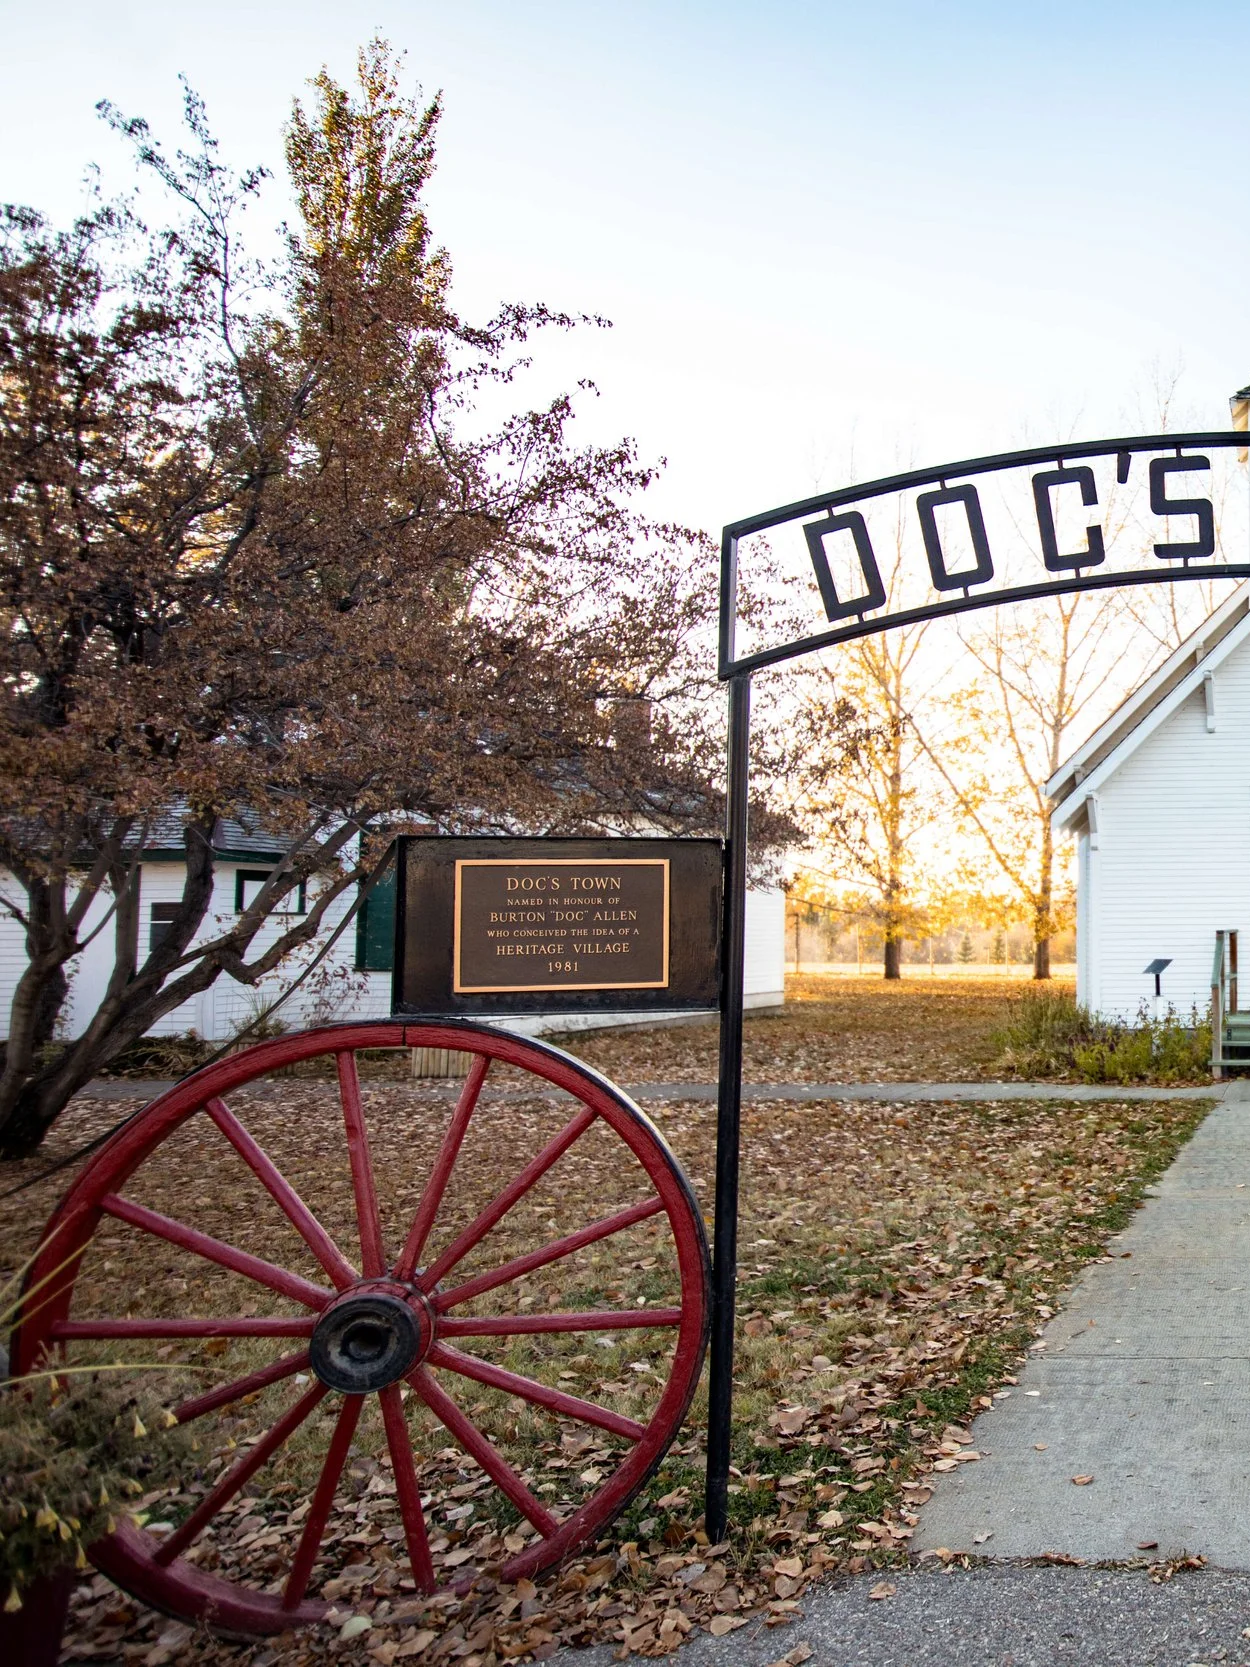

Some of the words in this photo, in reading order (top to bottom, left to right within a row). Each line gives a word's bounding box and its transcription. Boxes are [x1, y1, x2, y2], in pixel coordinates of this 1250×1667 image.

[802, 451, 1216, 623] DOC'S
[506, 876, 561, 891] DOC'S
[570, 877, 622, 890] TOWN
[507, 898, 543, 906] NAMED
[608, 897, 620, 905] OF
[490, 911, 546, 923] BURTON
[550, 910, 589, 922] "DOC"
[593, 910, 638, 921] ALLEN
[513, 929, 567, 937] CONCEIVED
[592, 928, 615, 936] IDEA
[618, 928, 630, 936] OF
[496, 943, 565, 956] HERITAGE
[572, 942, 630, 954] VILLAGE
[548, 961, 579, 973] 1981
